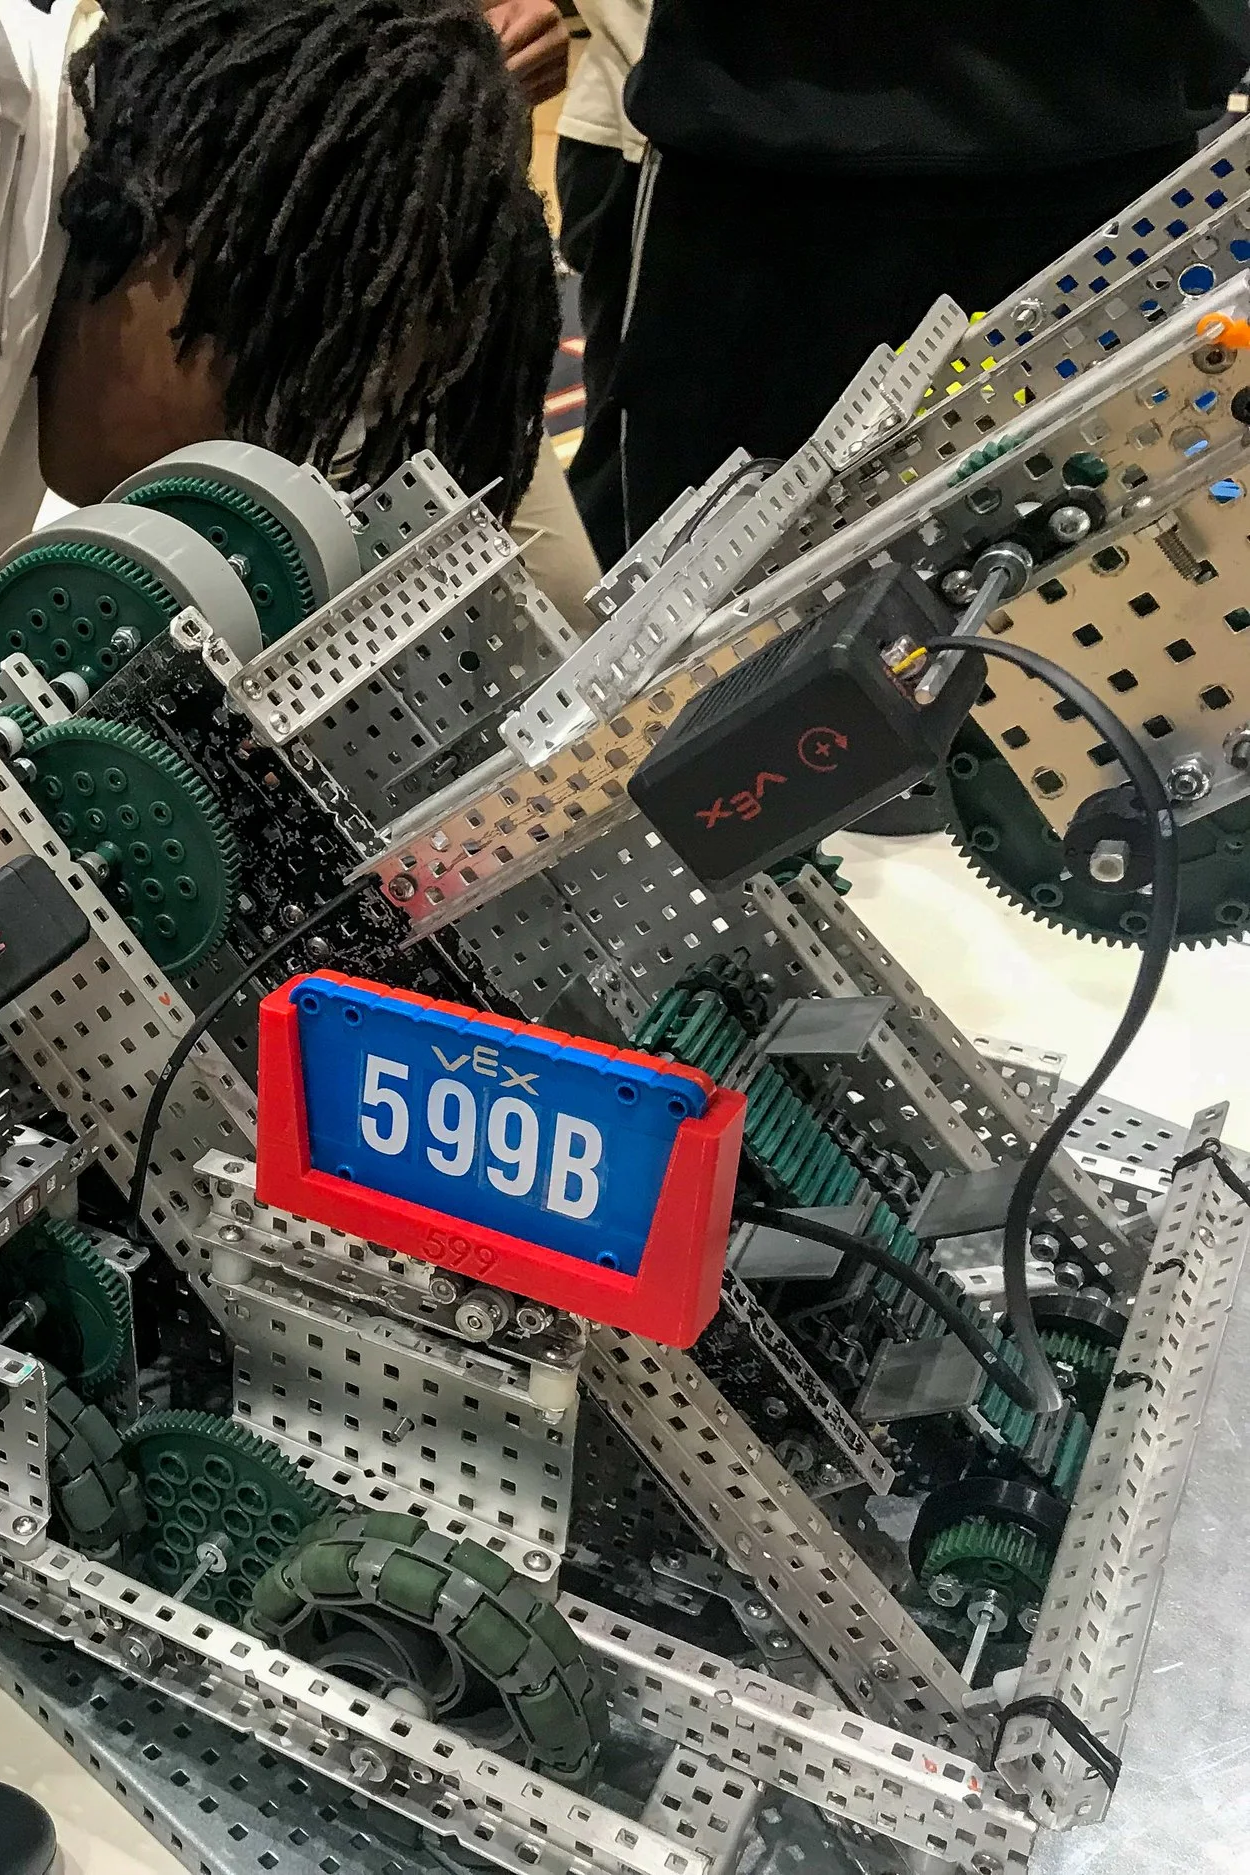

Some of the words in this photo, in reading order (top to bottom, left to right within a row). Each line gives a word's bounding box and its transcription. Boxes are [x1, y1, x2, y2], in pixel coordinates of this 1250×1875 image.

[695, 771, 788, 829] VEX
[431, 1045, 540, 1096] VEX
[360, 1054, 602, 1219] 599B
[421, 1228, 498, 1277] 599
